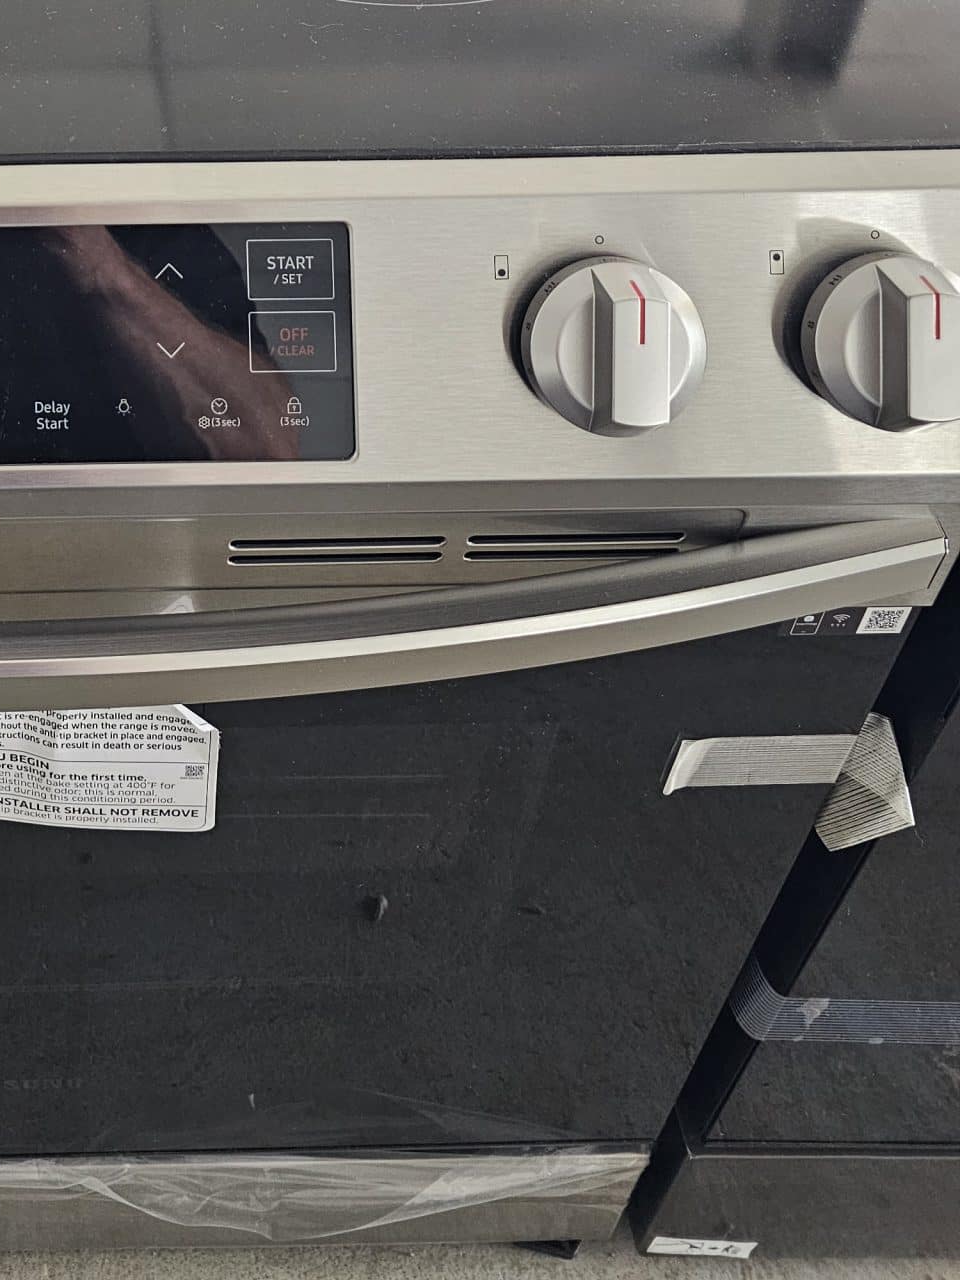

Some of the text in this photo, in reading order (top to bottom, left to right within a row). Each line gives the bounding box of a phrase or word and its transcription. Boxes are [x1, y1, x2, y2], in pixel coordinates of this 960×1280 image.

[266, 255, 314, 270] START
[280, 328, 309, 342] OFF
[34, 401, 71, 416] Delay
[36, 417, 70, 430] Start
[23, 723, 38, 732] the
[40, 726, 72, 740] anti-tip
[74, 732, 108, 740] bracket
[120, 732, 145, 742] place
[166, 734, 207, 745] engaged.
[10, 753, 50, 770] BEGIN
[16, 765, 46, 778] using
[50, 772, 66, 781] for
[69, 773, 88, 781] the
[91, 773, 116, 782] first
[64, 806, 107, 816] SHALL
[110, 808, 138, 816] NOT
[142, 808, 200, 818] REMOVE
